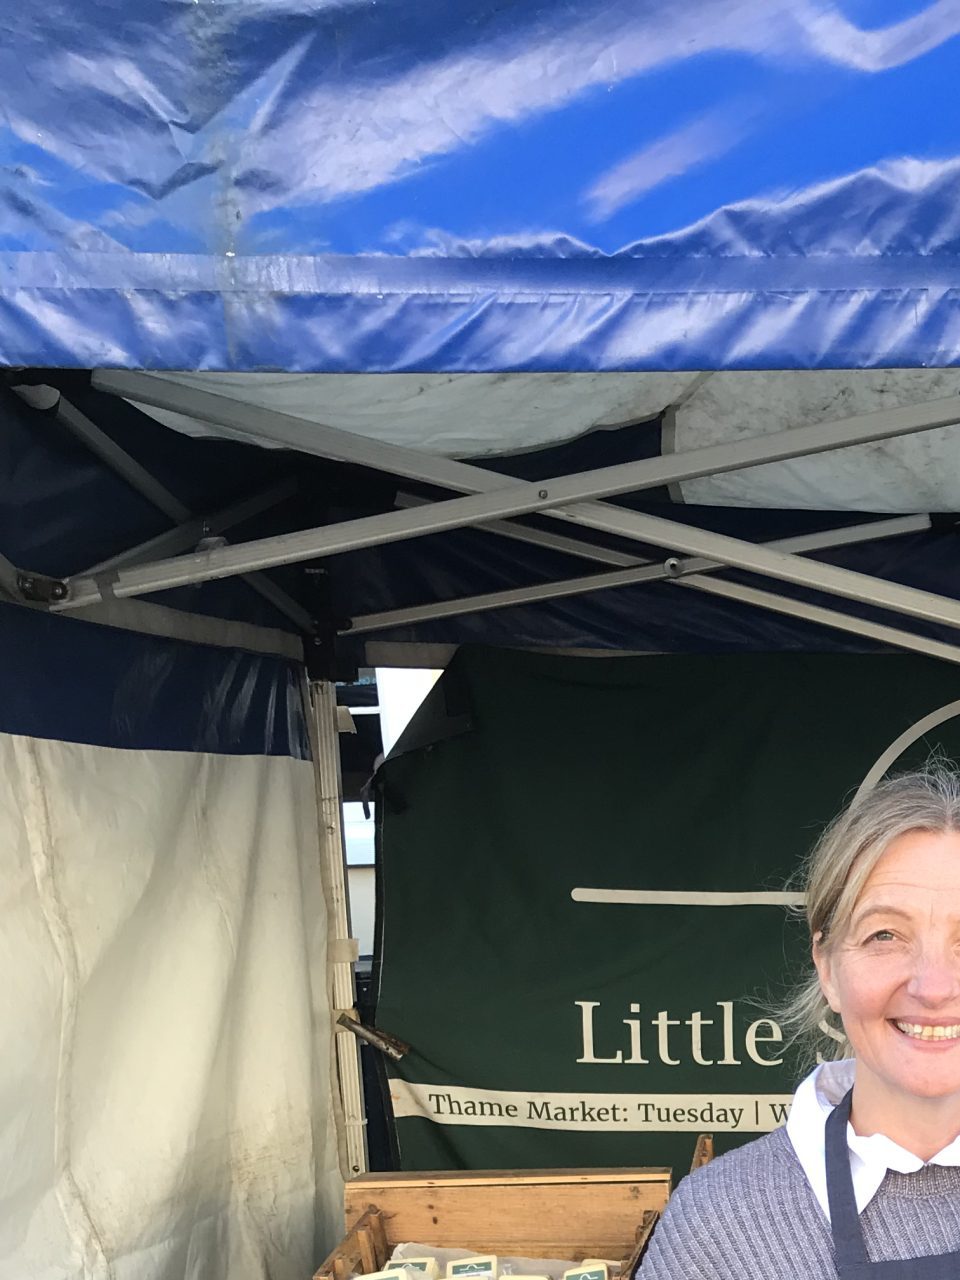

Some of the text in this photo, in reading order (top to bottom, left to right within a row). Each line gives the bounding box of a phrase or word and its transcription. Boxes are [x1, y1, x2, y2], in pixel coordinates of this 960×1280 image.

[575, 1001, 784, 1066] Little
[428, 1093, 744, 1128] Thame Market: Tuesday
